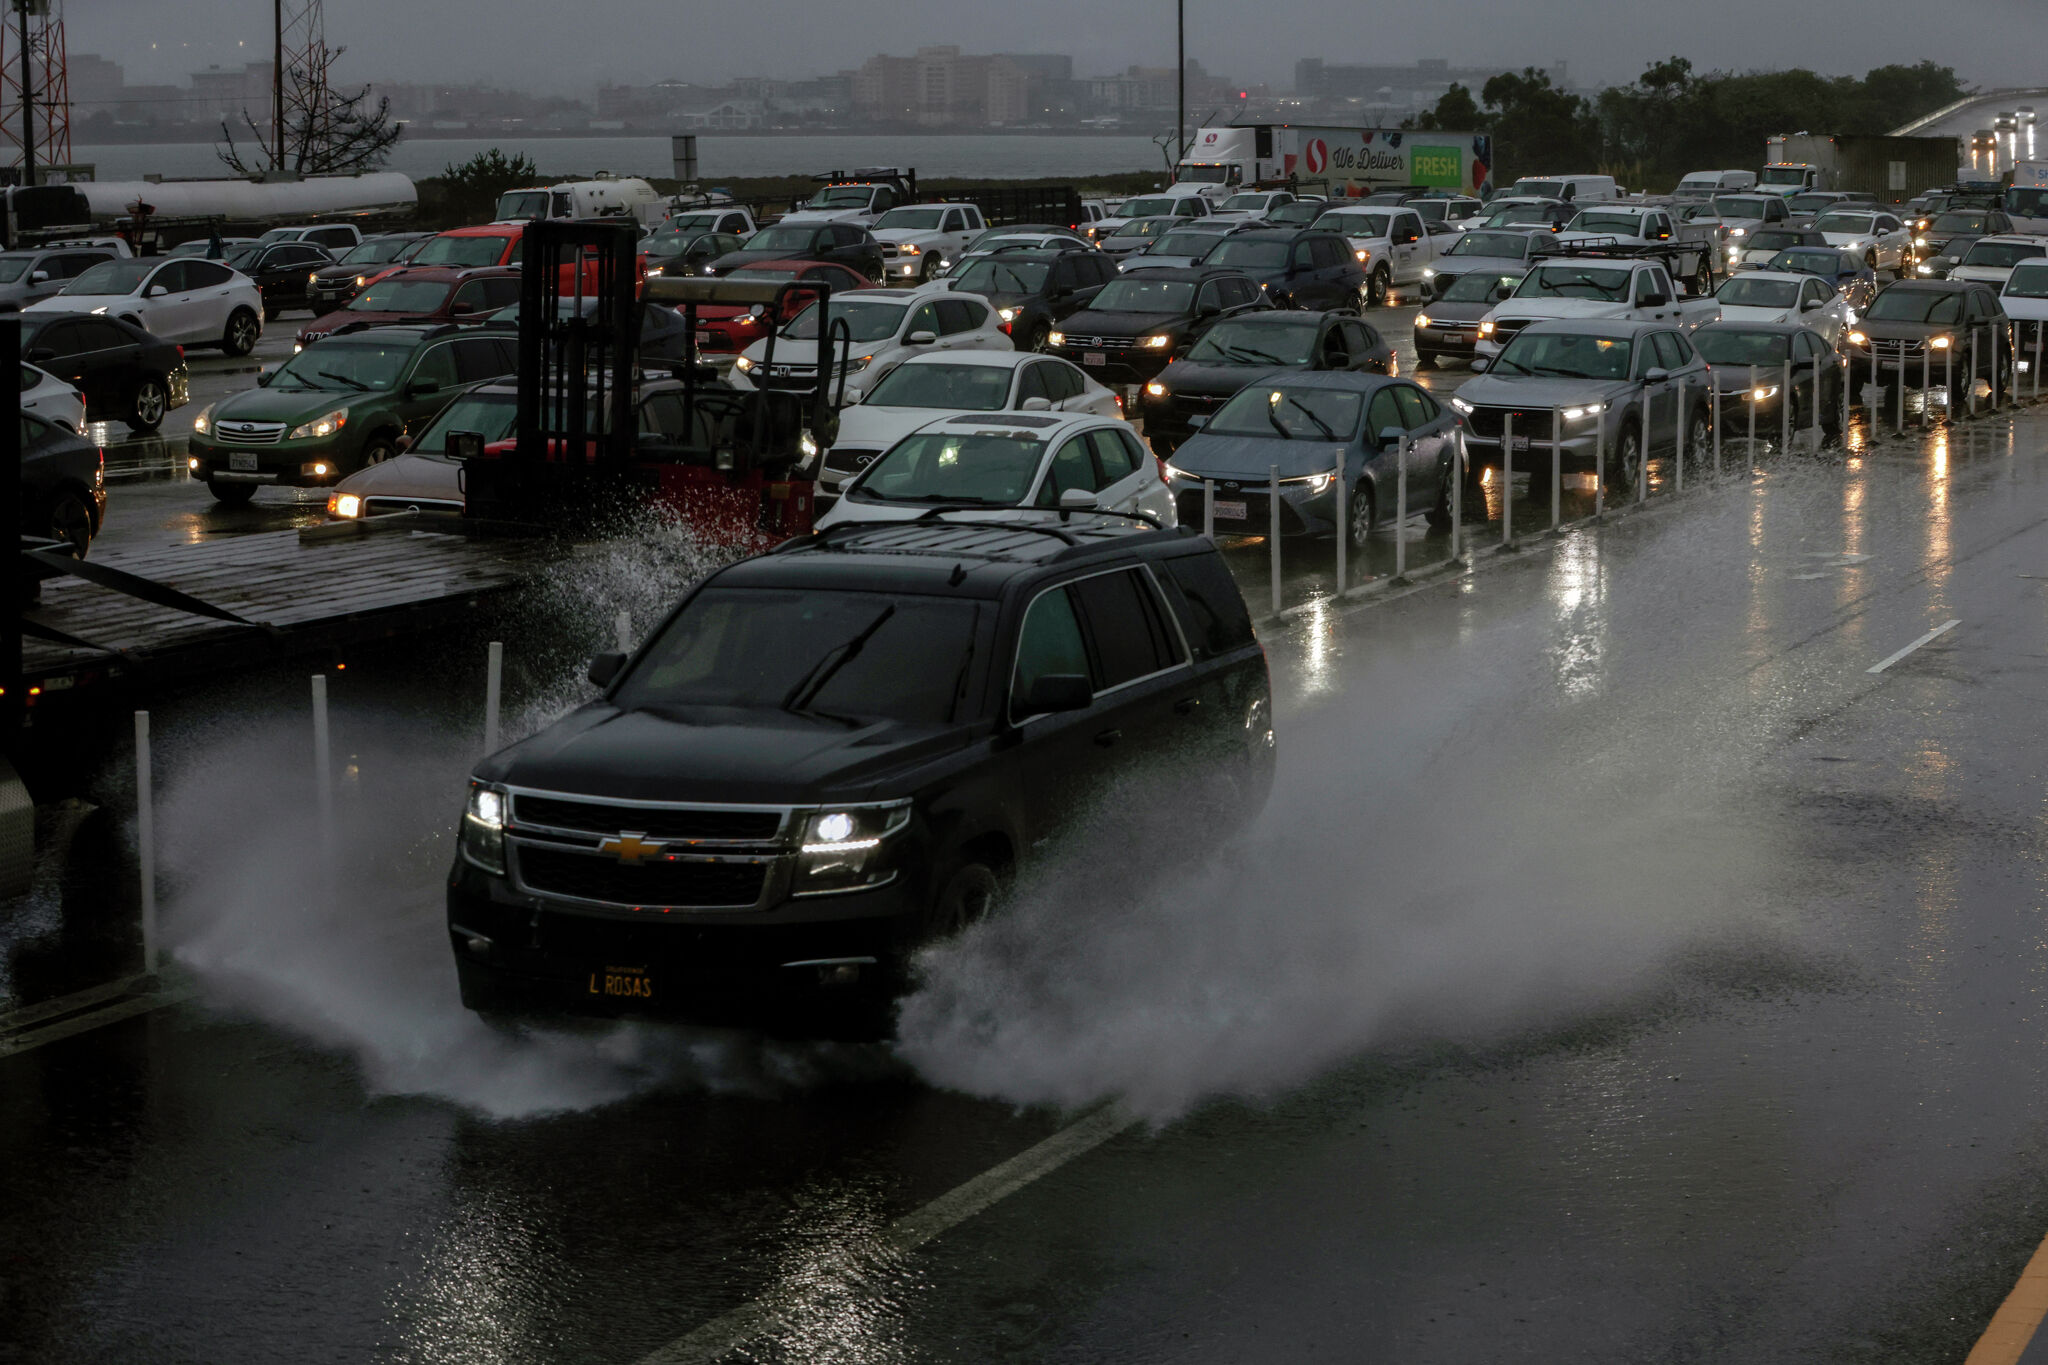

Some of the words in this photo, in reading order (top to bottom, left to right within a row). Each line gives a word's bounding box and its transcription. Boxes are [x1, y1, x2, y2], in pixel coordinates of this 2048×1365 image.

[1333, 147, 1354, 169] We
[1357, 147, 1405, 170] Deliver
[1415, 156, 1457, 176] FRESH
[589, 972, 600, 994] L
[604, 975, 652, 998] ROSAS
